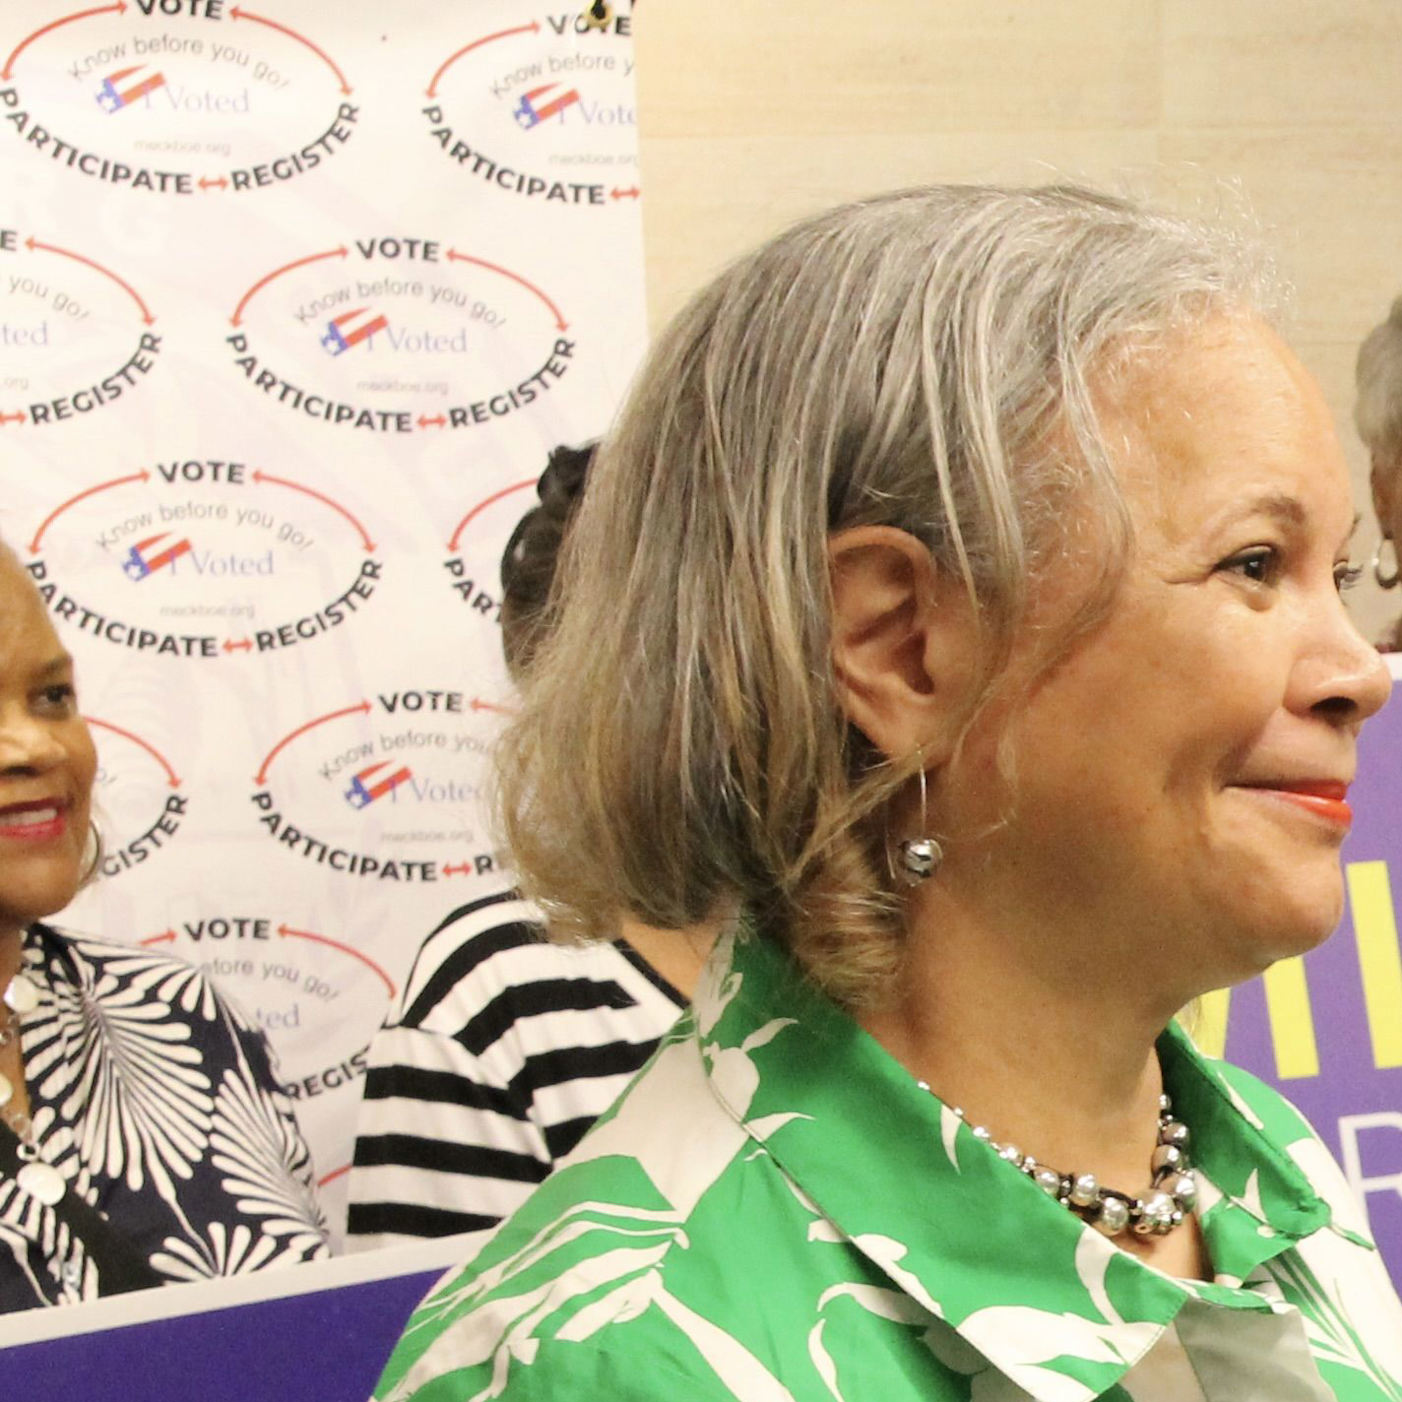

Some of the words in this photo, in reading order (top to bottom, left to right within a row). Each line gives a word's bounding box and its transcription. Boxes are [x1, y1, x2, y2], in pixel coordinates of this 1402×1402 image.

[136, 0, 224, 20] VOTE
[547, 14, 632, 36] VOE
[68, 43, 127, 83] Know
[133, 34, 203, 56] before
[211, 42, 250, 67] you
[490, 62, 543, 100] Know
[548, 51, 616, 73] before
[163, 85, 250, 114] Voted
[578, 100, 637, 126] Vote
[0, 87, 194, 195] PARTICIPATE
[230, 101, 360, 191] REGISTER
[422, 104, 605, 205] PARTICIPATE
[356, 238, 440, 263] VOTE
[8, 274, 50, 299] you
[294, 287, 352, 326] Know
[357, 277, 424, 299] before
[430, 284, 468, 309] you
[2, 321, 49, 347] ted
[385, 328, 468, 353] Voted
[29, 331, 163, 425] REGISTER
[225, 332, 413, 433] PARTICIPATE
[449, 337, 576, 429] REGISTER
[157, 461, 246, 484] VOTE
[95, 512, 153, 551] Know
[158, 501, 228, 523] before
[235, 508, 275, 531] you
[189, 551, 274, 577] Voted
[25, 560, 219, 658] PARTICIPATE
[254, 558, 383, 652] REGISTER
[378, 690, 464, 714] VOTE
[318, 741, 374, 780] Know
[380, 729, 448, 752] before
[101, 794, 188, 876] GISTER
[251, 791, 439, 883] PARTICIPATE
[183, 918, 271, 942] VOTE
[262, 961, 300, 982] you
[285, 1043, 370, 1101] REGIS
